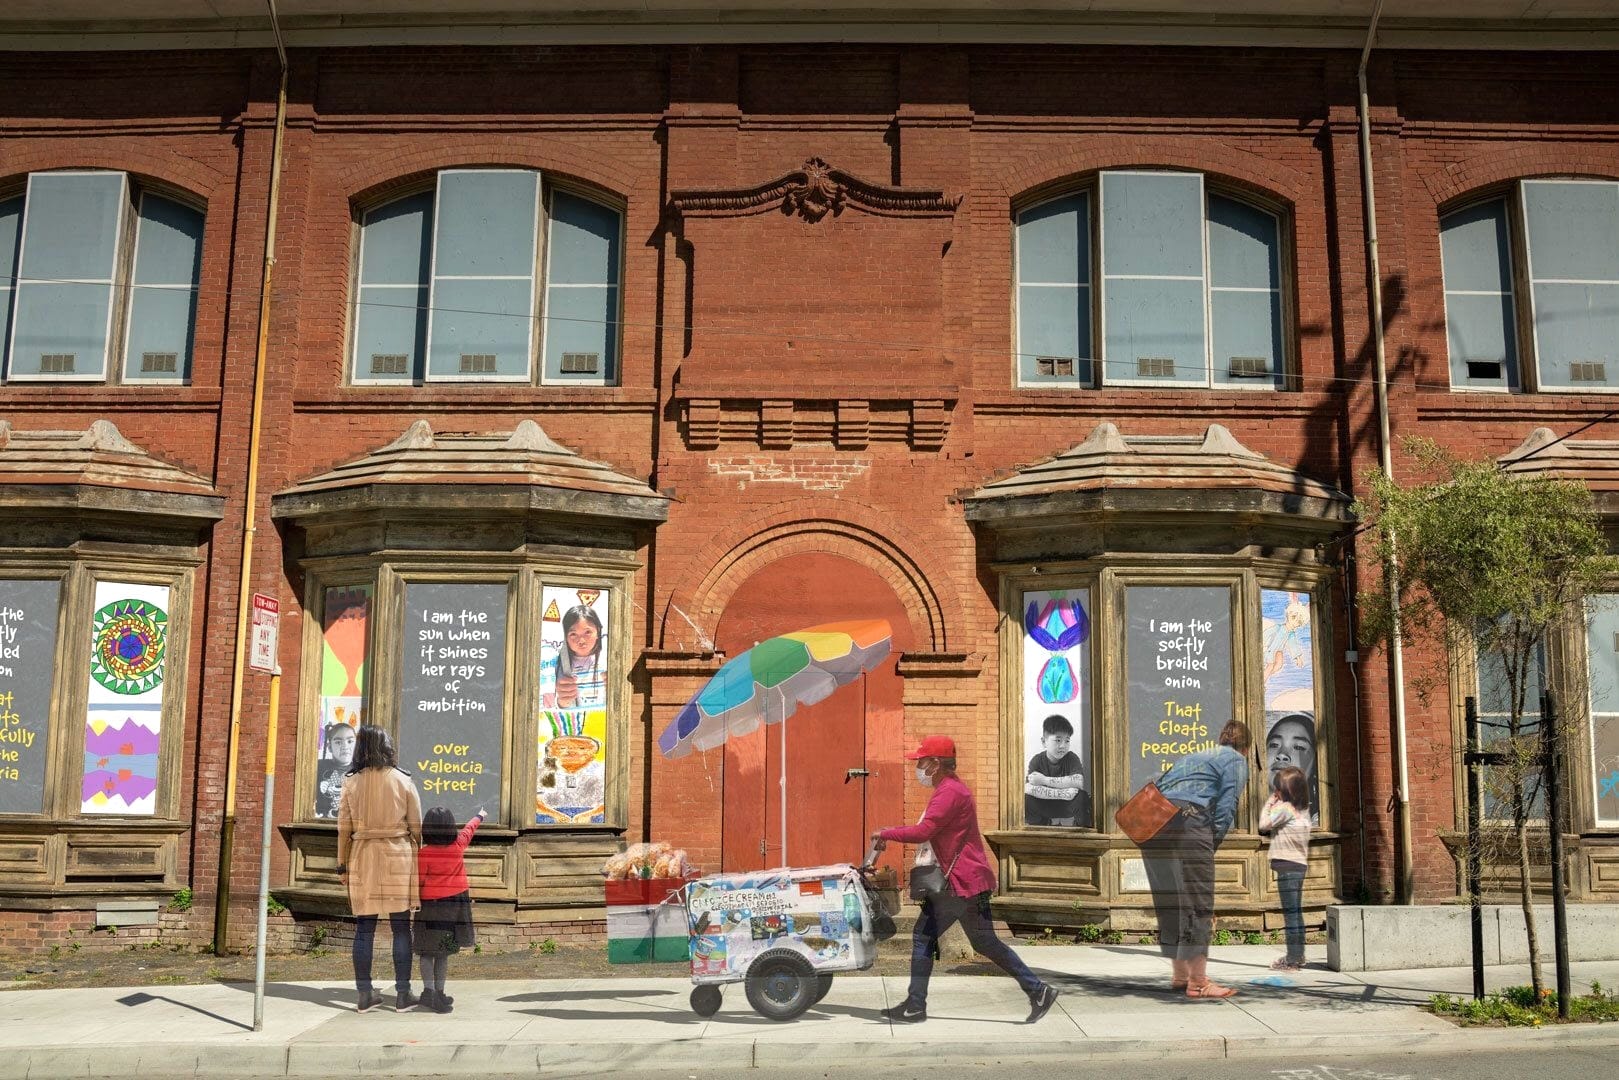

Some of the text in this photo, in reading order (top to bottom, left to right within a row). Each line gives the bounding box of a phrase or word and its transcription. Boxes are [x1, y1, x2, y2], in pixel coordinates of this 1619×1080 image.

[0, 606, 24, 626] the
[422, 608, 488, 627] I am the
[418, 628, 491, 641] sun when
[1149, 618, 1213, 635] I am the
[420, 644, 488, 662] it shines
[1158, 636, 1206, 656] softly
[421, 663, 486, 680] her rays
[1155, 655, 1208, 671] broiled
[444, 679, 462, 694] of
[1164, 674, 1202, 690] onion
[417, 697, 487, 716] ambition
[1163, 700, 1203, 722] That
[0, 709, 20, 728] ts
[1158, 720, 1208, 740] floats
[0, 748, 18, 761] he
[432, 742, 470, 756] over
[422, 776, 477, 796] street
